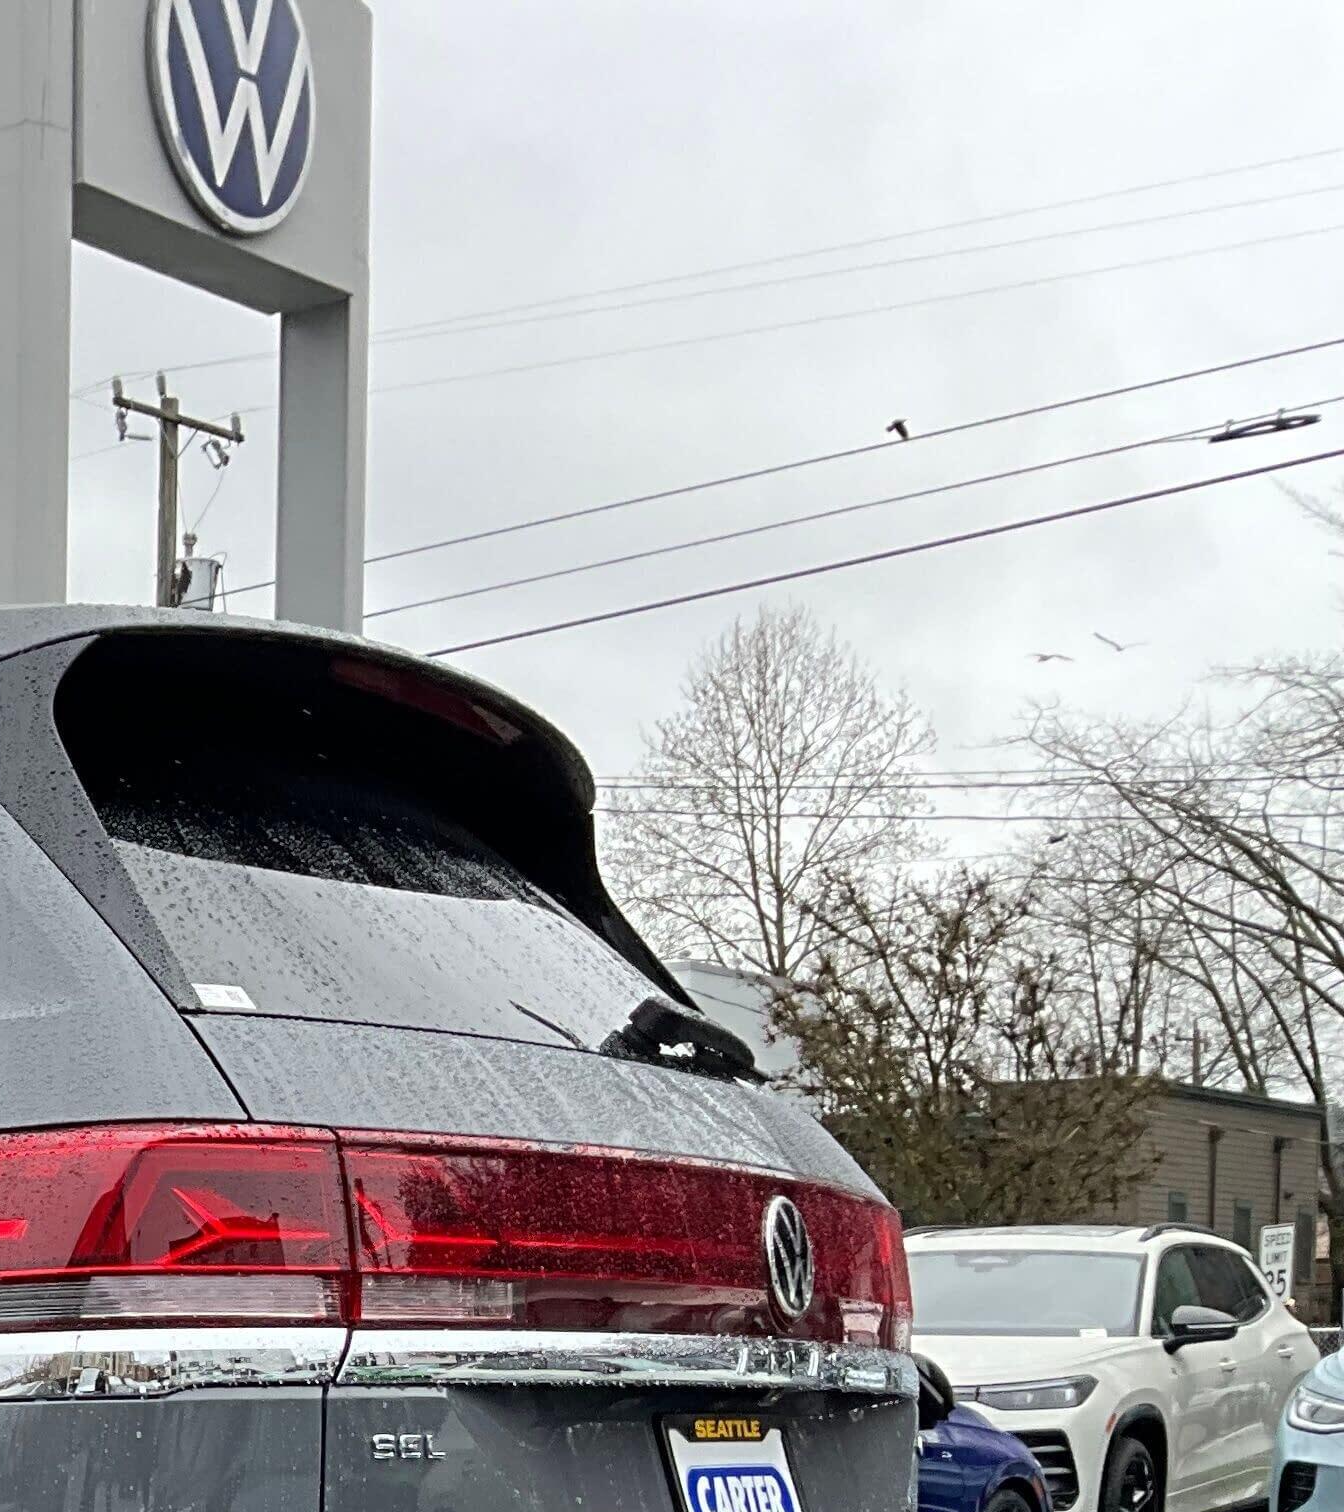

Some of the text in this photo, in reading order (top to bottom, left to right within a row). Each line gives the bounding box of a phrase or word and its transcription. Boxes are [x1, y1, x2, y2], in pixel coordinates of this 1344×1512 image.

[1264, 1232, 1292, 1247] SPEED
[771, 1199, 813, 1308] VW
[1266, 1250, 1288, 1265] LIMIT
[694, 1419, 761, 1438] SEATTLE
[372, 1433, 446, 1459] SEL
